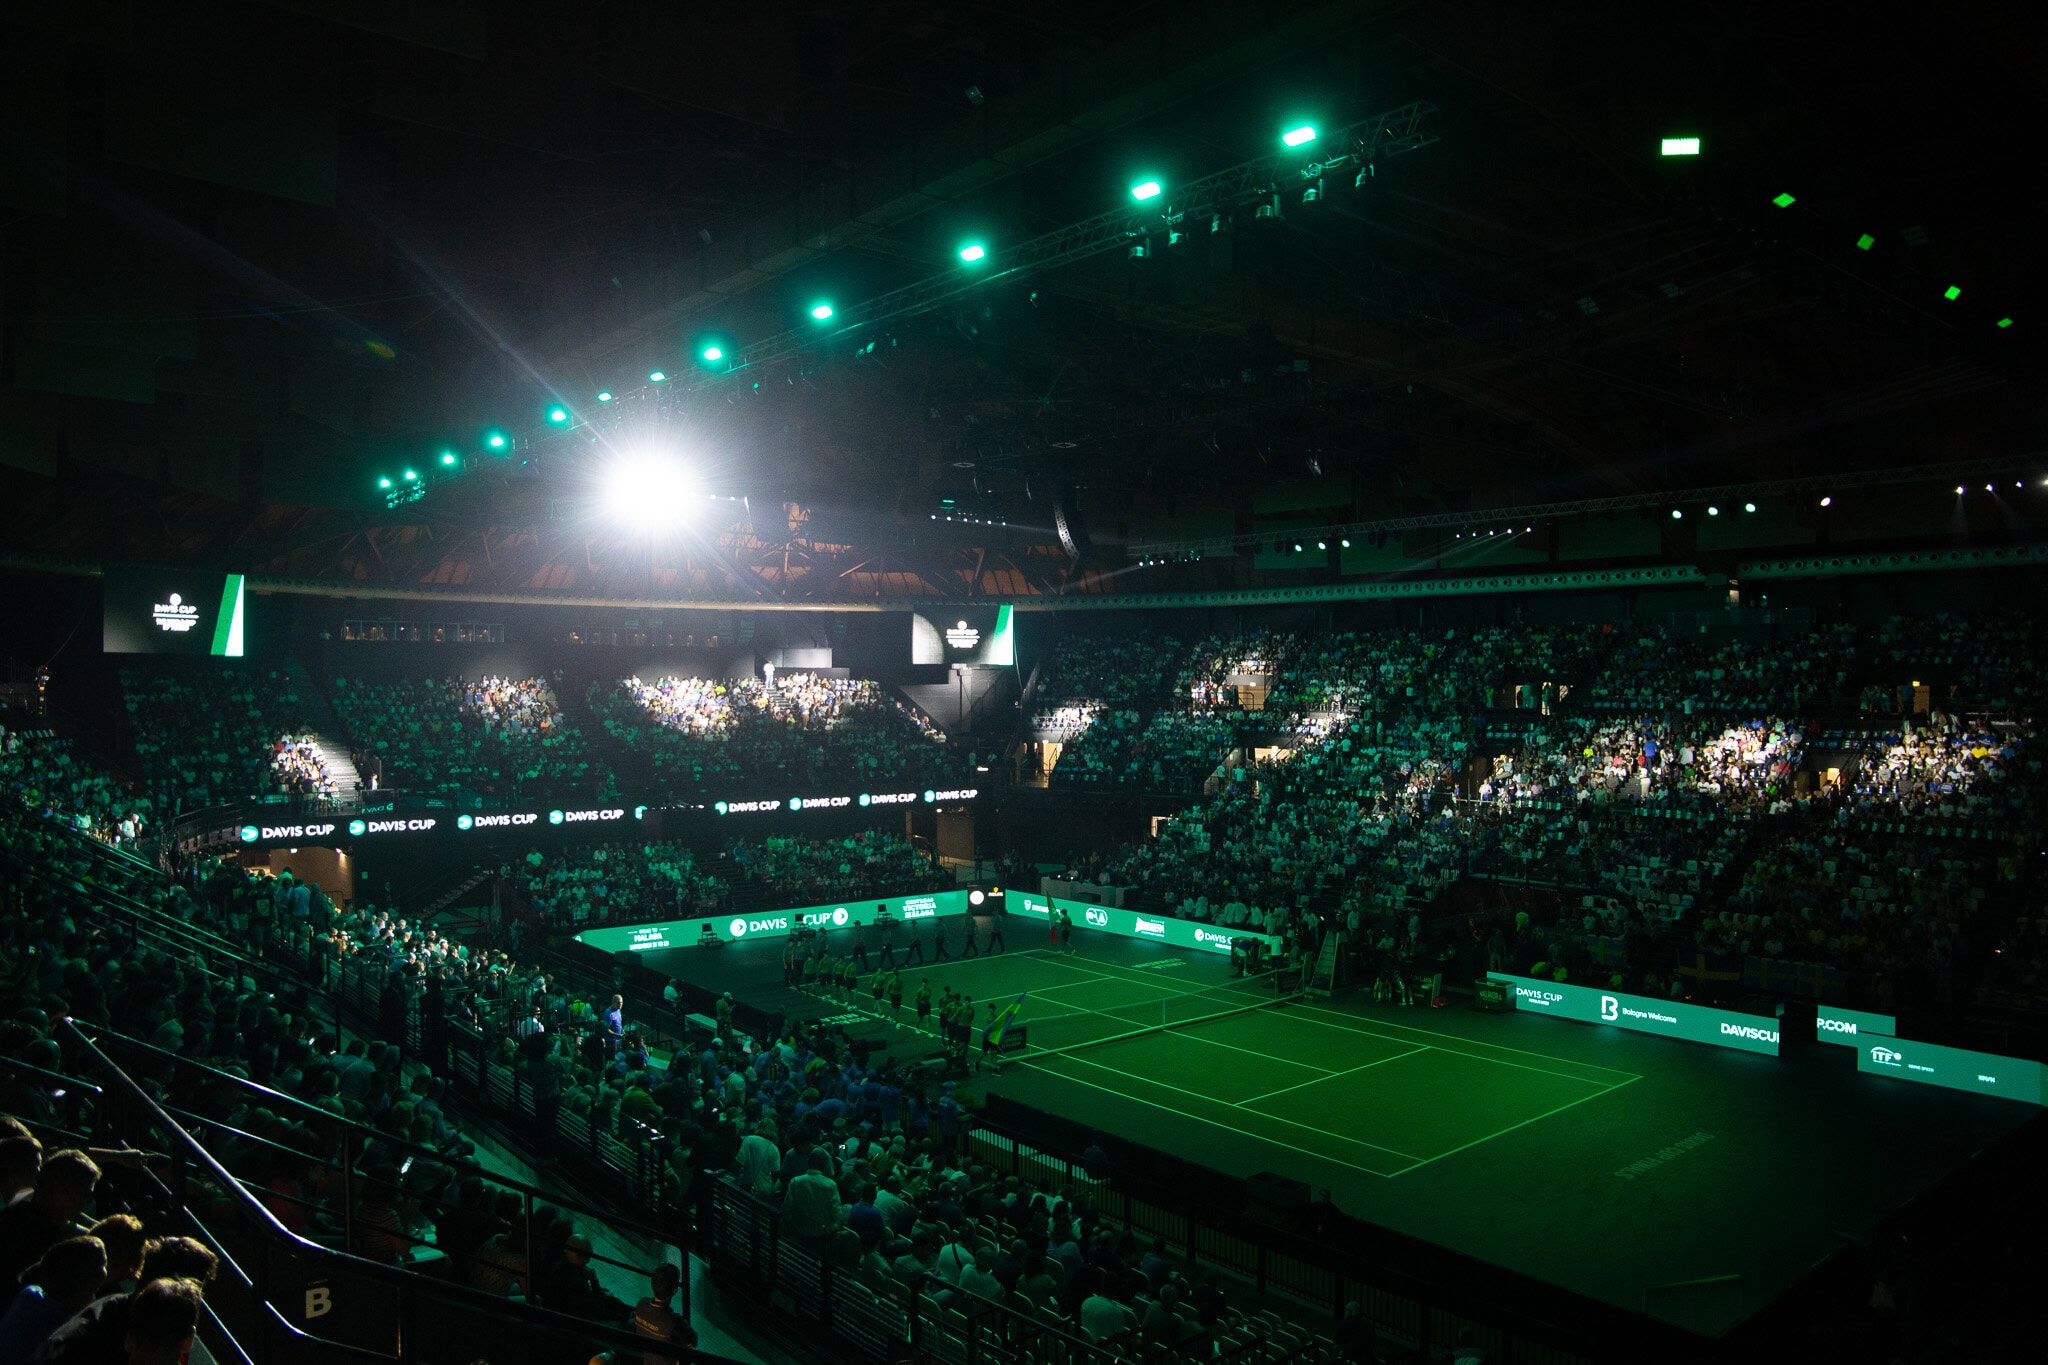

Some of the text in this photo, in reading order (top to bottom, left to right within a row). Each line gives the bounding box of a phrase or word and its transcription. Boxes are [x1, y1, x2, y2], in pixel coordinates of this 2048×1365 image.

[872, 793, 917, 804] DAVIS CUP
[936, 790, 978, 800] DAVIS CUP
[729, 801, 780, 813] DAVIS CUP
[803, 797, 851, 808] DAVIS CUP
[475, 813, 537, 827] DAVIS CUP
[565, 809, 624, 822] DAVIS CUP
[262, 824, 335, 839] DAVIS CUP
[368, 819, 436, 832] DAVIS CUP
[750, 913, 831, 932] DAVIS CUP
[1204, 932, 1226, 944] DAVIS
[1516, 987, 1541, 999] DAVIS
[1543, 992, 1562, 1002] CUP
[1622, 1007, 1677, 1023] Bologna Welcome
[1816, 1018, 1857, 1034] P.COM
[1873, 1050, 1892, 1062] ITF
[305, 1287, 333, 1319] B
